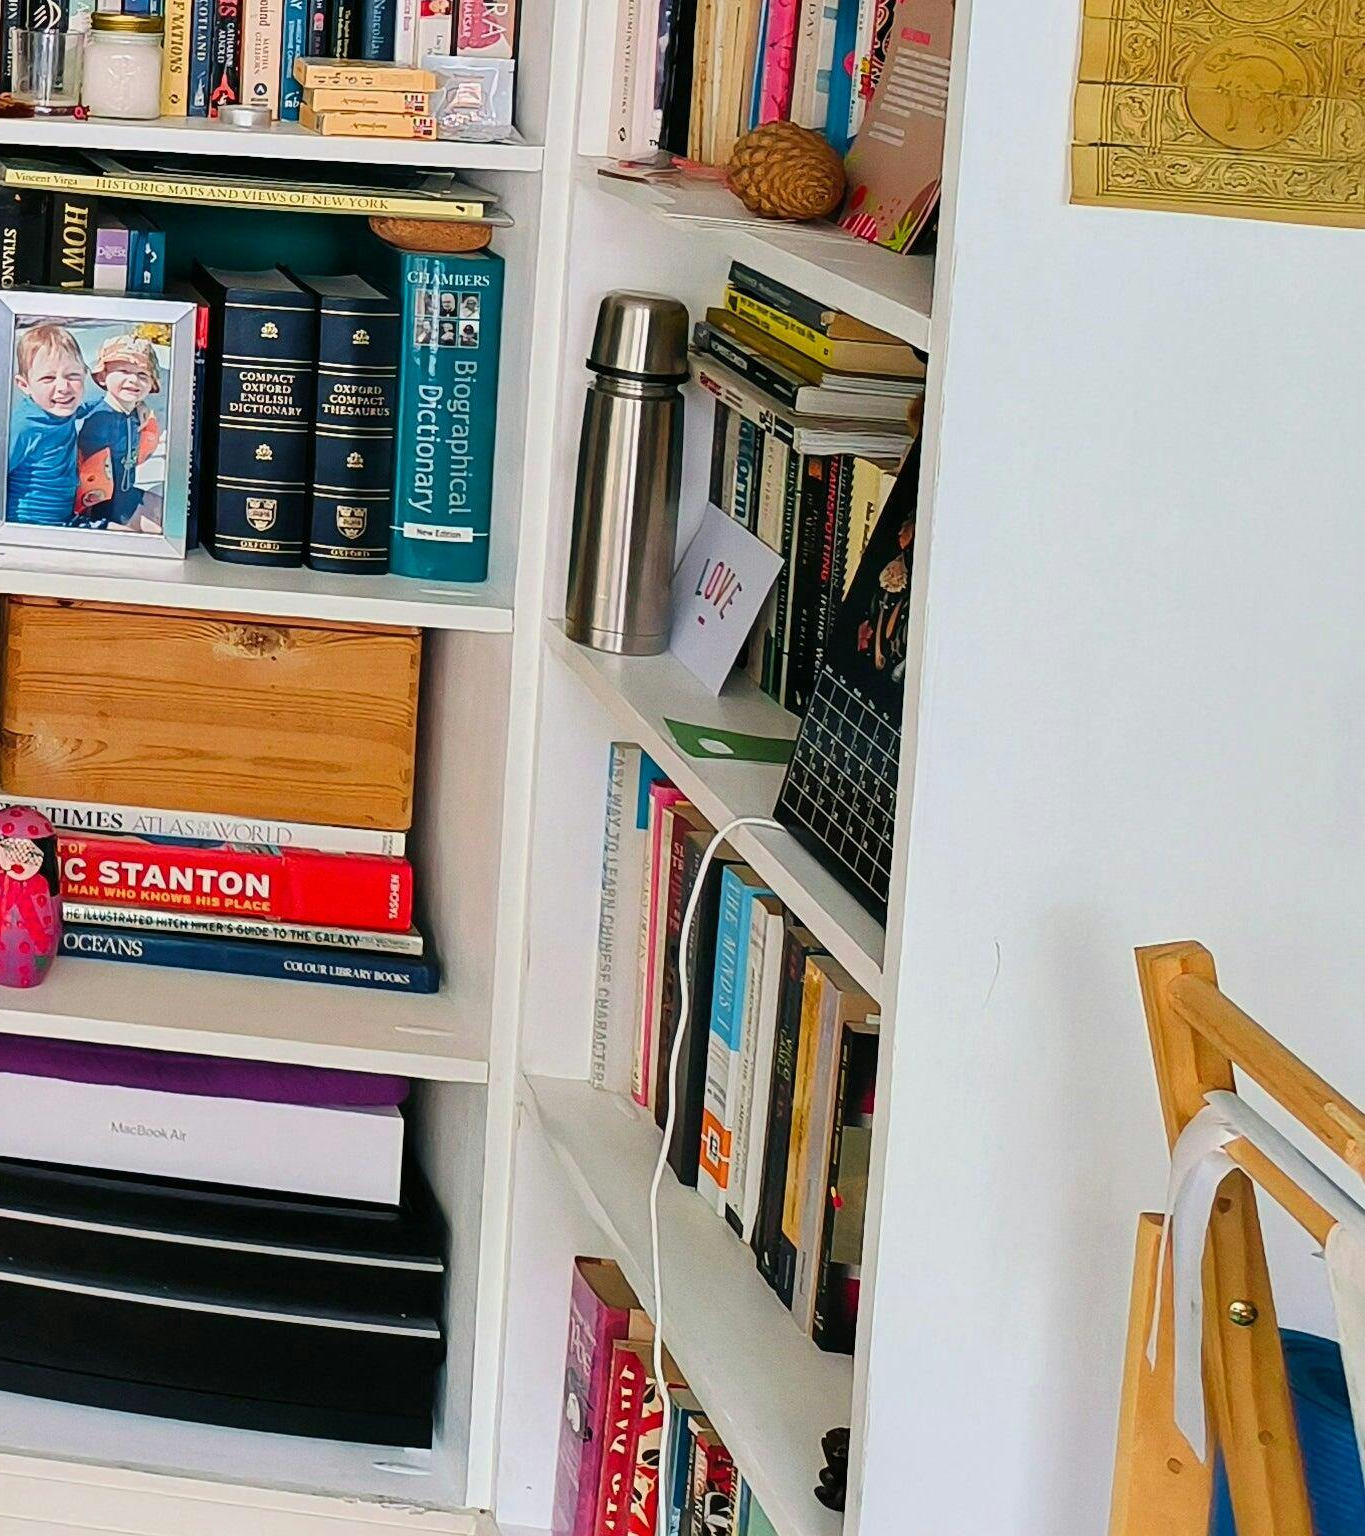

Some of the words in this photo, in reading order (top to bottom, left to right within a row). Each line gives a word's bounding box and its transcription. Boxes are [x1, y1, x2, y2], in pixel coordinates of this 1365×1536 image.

[168, 13, 185, 75] NATIONS
[94, 177, 166, 195] HISTORIC
[167, 184, 207, 199] MAPS
[208, 187, 239, 201] AND
[241, 189, 287, 204] VIEWS
[289, 193, 310, 205] OF
[311, 193, 347, 208] NEW
[348, 196, 390, 211] YORK
[407, 270, 490, 287] CHAMBERS
[239, 370, 296, 384] COMPACT
[242, 382, 292, 395] OXFORD
[333, 383, 382, 395] OXFORD
[229, 402, 302, 417] DICTIONARY
[239, 392, 293, 405] ENGLISH
[321, 403, 390, 417] THESAURUS
[329, 393, 385, 406] COMPACT
[409, 383, 443, 515] Dictionary
[447, 360, 478, 515] Biographical
[695, 558, 743, 620] LOVE
[49, 807, 124, 829] TIMES
[97, 861, 272, 899] STANTON
[67, 883, 99, 897] MAN
[102, 886, 137, 899] WHO
[139, 888, 193, 905] KNOWS
[195, 892, 222, 907] HIS
[223, 895, 271, 913] PLACE
[388, 873, 401, 920] TASCHEN
[62, 932, 144, 957] OCEANS
[599, 914, 615, 983] CHINESE
[283, 959, 327, 975] COLOUR
[328, 964, 372, 980] LIBRARY
[372, 968, 411, 984] BOOKS
